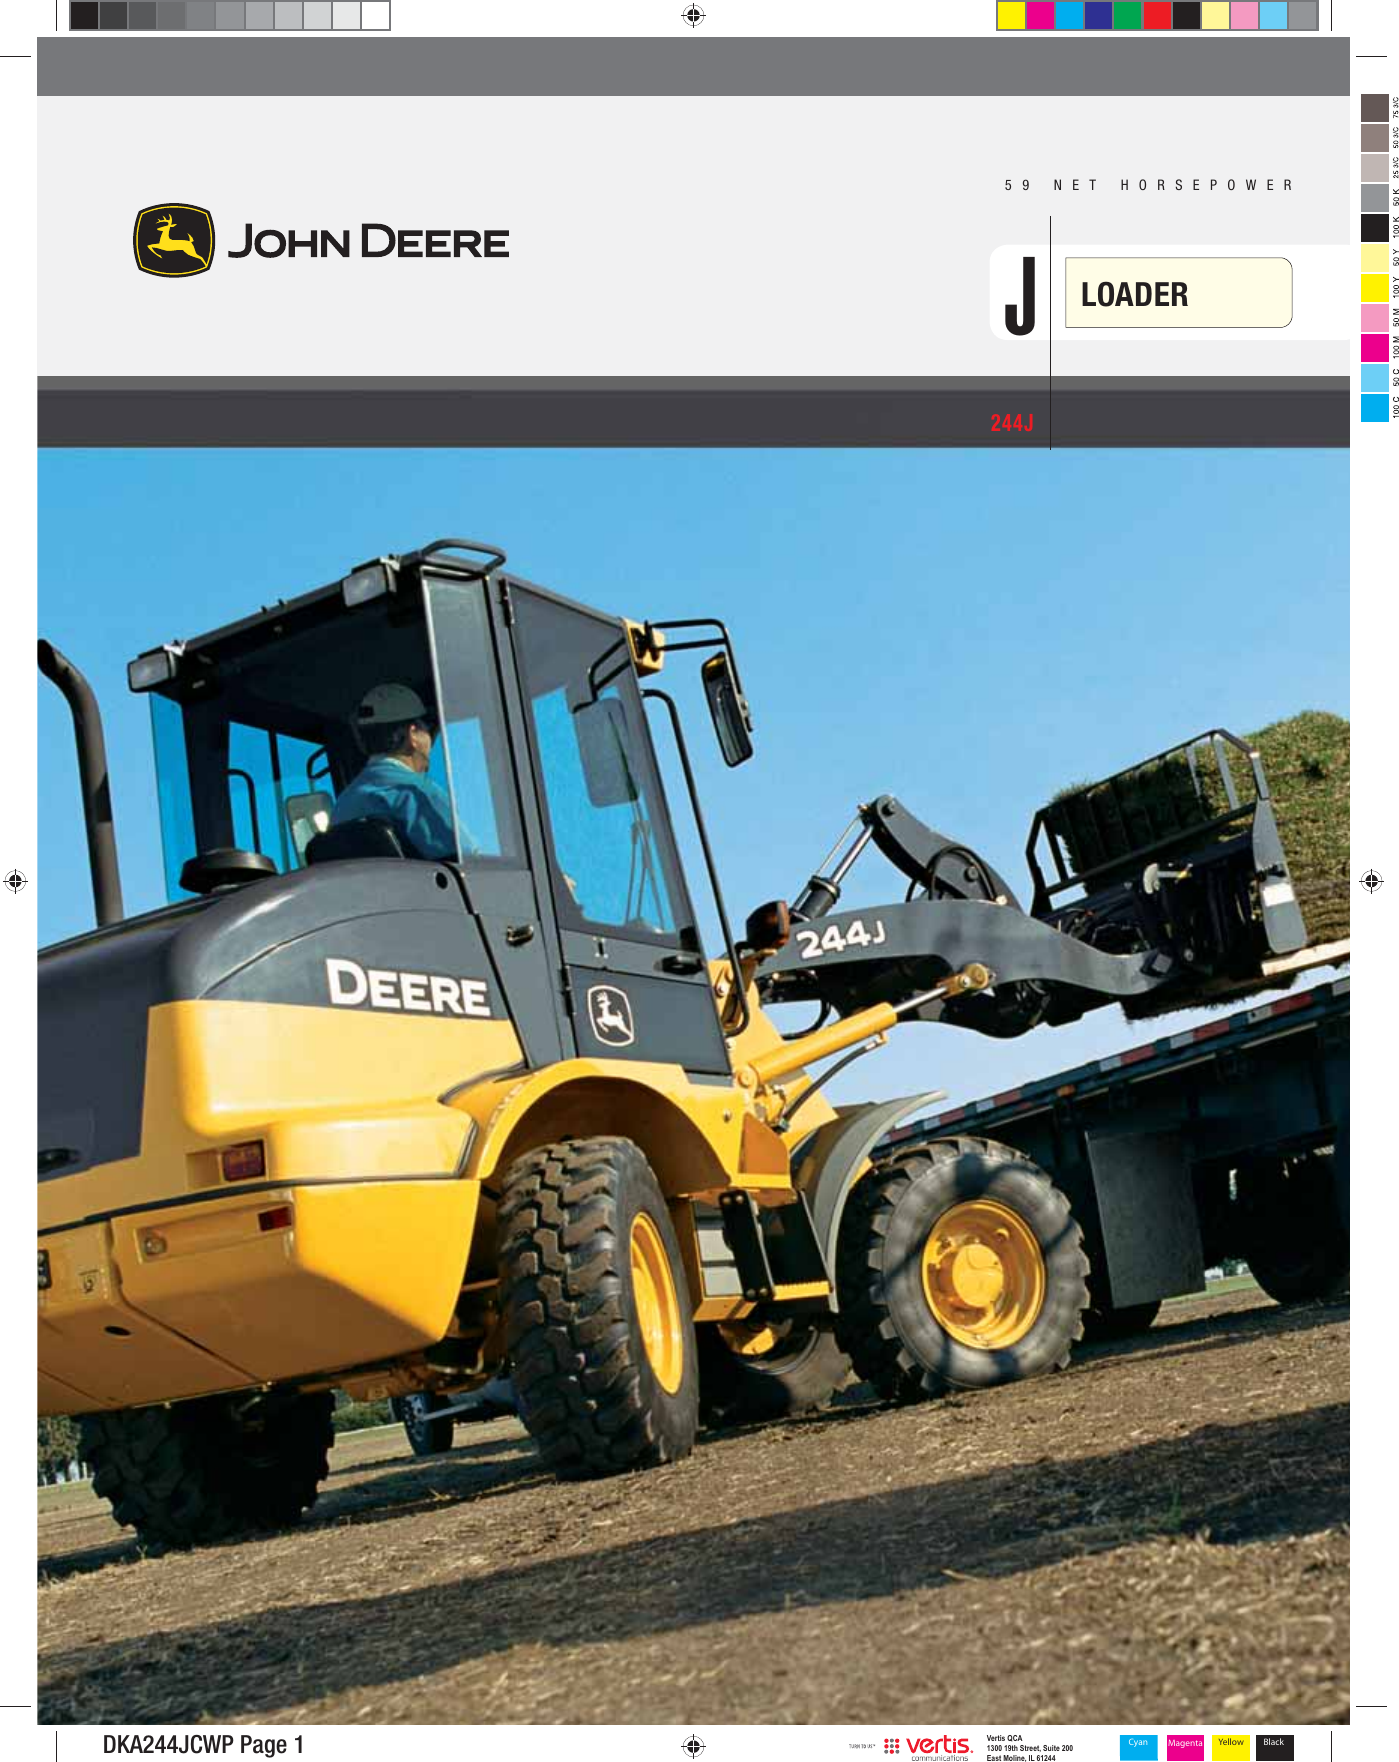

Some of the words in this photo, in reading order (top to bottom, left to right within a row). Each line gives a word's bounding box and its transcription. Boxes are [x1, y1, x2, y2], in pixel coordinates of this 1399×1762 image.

[1392, 110, 1399, 118] 75
[1392, 140, 1399, 148] 50
[1392, 170, 1399, 178] 25
[1004, 178, 1030, 191] 59
[1053, 178, 1097, 191] NET
[1120, 178, 1292, 191] HORSEPOWER
[1392, 197, 1399, 206] 50
[227, 223, 351, 258] JOHN
[361, 223, 510, 258] DEERE
[1392, 257, 1399, 266] 50
[1004, 256, 1036, 336] J
[1081, 281, 1189, 308] LOADER
[1392, 308, 1399, 316] M
[1392, 318, 1399, 327] 50
[1392, 335, 1399, 343] M
[1392, 377, 1399, 386] 50
[990, 414, 1034, 432] 244J
[796, 920, 886, 959] 244J
[325, 958, 491, 1017] DEERE
[986, 1734, 1006, 1742] Vertis
[1007, 1734, 1023, 1743] QCA
[1128, 1737, 1149, 1748] Cyan
[1218, 1737, 1245, 1746] Yellow
[1263, 1737, 1285, 1746] Black
[103, 1734, 234, 1754] DKA244JCWP
[240, 1734, 288, 1758] Page
[294, 1734, 303, 1754] 1
[1167, 1738, 1203, 1749] Magenta
[986, 1744, 1003, 1752] 1300
[1004, 1744, 1019, 1752] 19th
[1019, 1744, 1042, 1753] Street,
[1042, 1744, 1061, 1752] Suite
[1061, 1744, 1074, 1752] 200
[986, 1754, 1002, 1762] East
[1003, 1754, 1027, 1762] Moline,
[1028, 1754, 1035, 1762] IL
[1036, 1754, 1057, 1762] 61244
